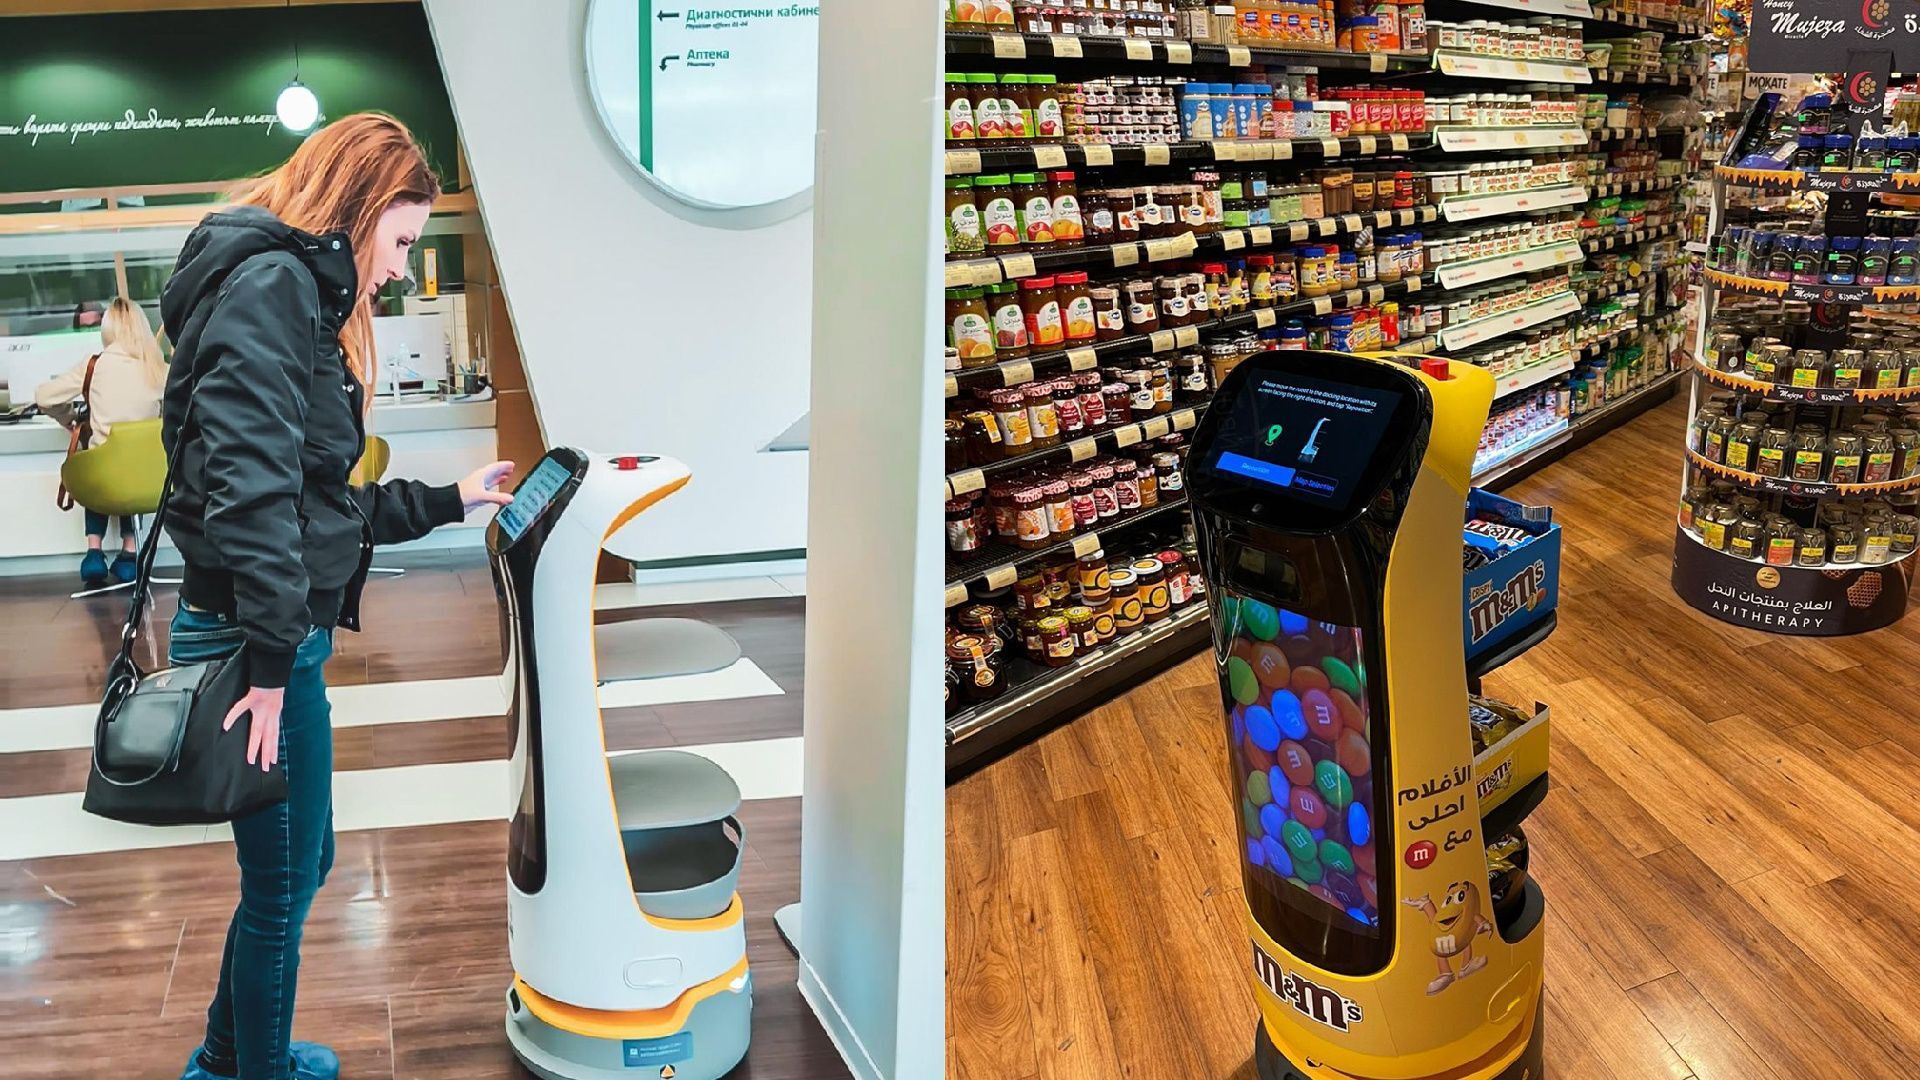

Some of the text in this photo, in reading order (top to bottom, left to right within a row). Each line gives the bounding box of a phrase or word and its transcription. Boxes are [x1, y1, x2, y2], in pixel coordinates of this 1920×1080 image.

[687, 8, 774, 22] Диагностични
[1770, 12, 1846, 39] Mujeza
[687, 49, 730, 60] Аптека
[1749, 76, 1788, 89] MOKATE
[1707, 582, 1833, 615] العلاج بمنتجات النحل
[1712, 601, 1824, 628] APITHERAPY
[1398, 764, 1472, 807] الأفلام
[1442, 828, 1473, 852] مع
